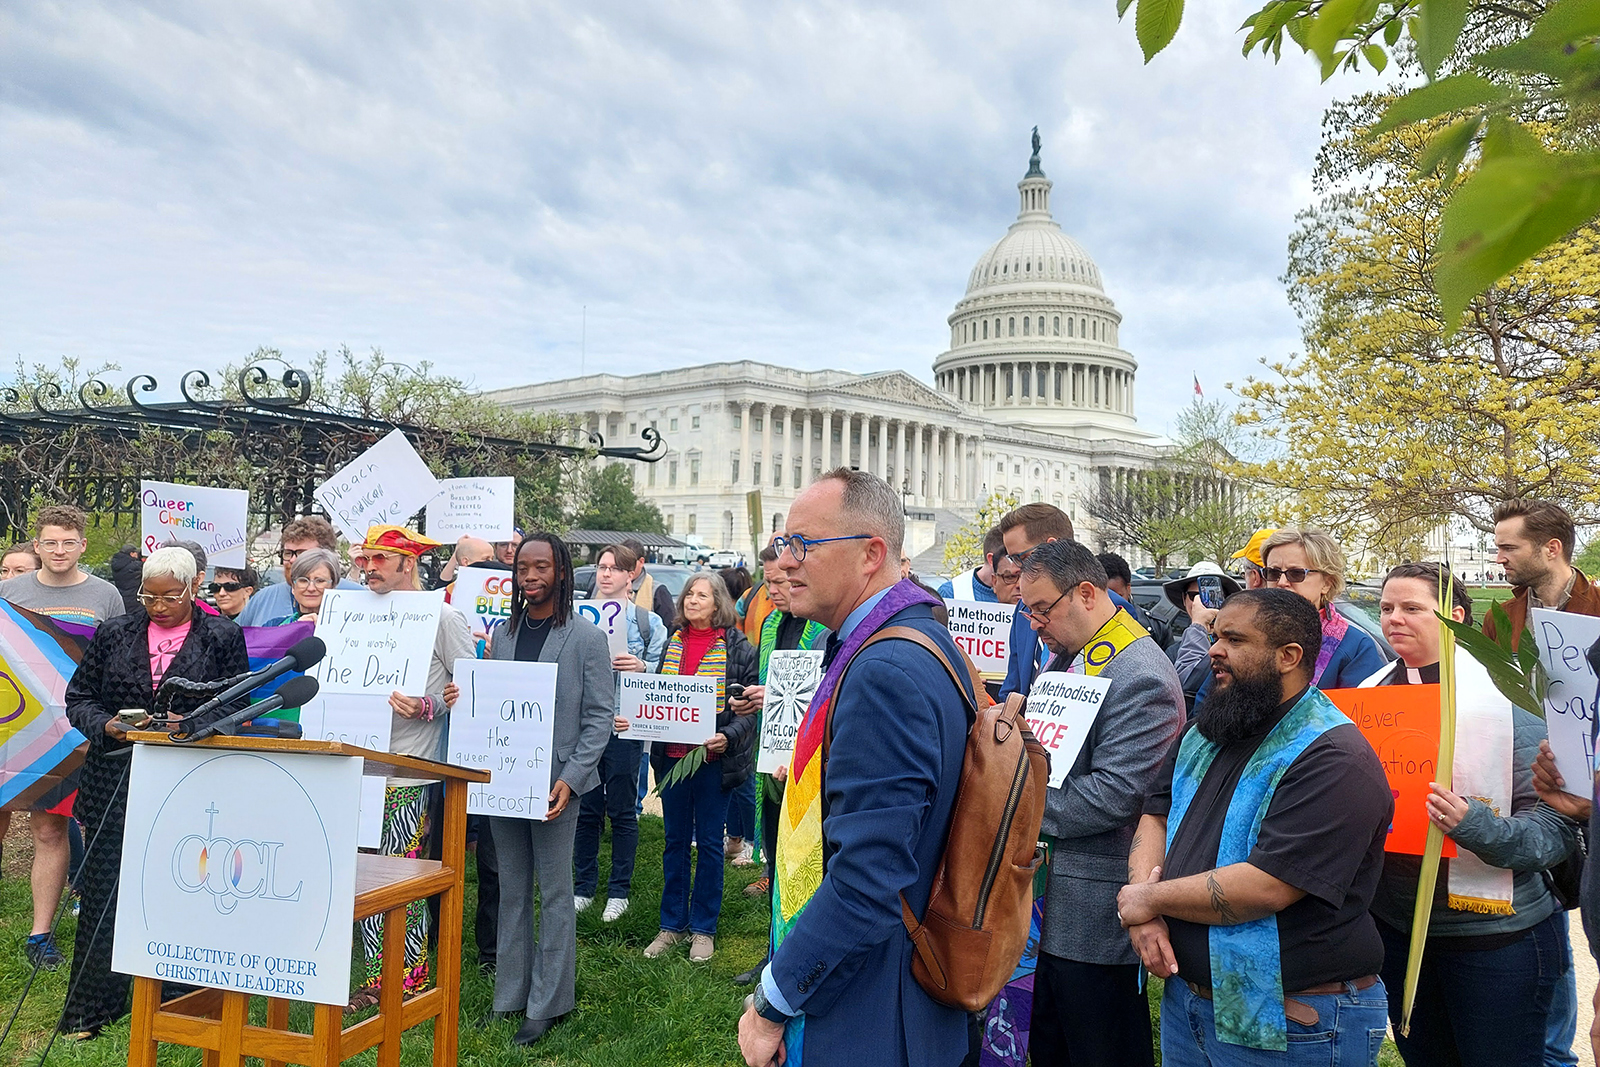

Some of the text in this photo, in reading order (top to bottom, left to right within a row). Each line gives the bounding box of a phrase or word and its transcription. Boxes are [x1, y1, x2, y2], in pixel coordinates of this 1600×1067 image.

[142, 490, 194, 512] Queer
[159, 510, 215, 532] Christian
[203, 528, 245, 555] nafraid
[485, 576, 512, 596] GO
[320, 594, 341, 625] If
[340, 610, 364, 634] you
[400, 611, 434, 628] power
[476, 596, 512, 616] BLE
[958, 607, 1014, 624] Methodis
[949, 620, 996, 636] tand for
[340, 636, 360, 656] you
[952, 636, 1005, 660] STICE
[363, 654, 410, 688] Devil
[470, 670, 543, 722] I am
[624, 678, 714, 694] United Methodists
[1040, 680, 1102, 705] Methodists
[645, 692, 691, 704] stand for
[1026, 699, 1067, 718] tand for
[636, 704, 700, 722] JUSTICE
[1350, 702, 1404, 729] Never
[486, 726, 511, 749] the
[766, 723, 798, 738] WELCO
[1027, 719, 1069, 750] TICE
[456, 746, 545, 774] queer joy of
[1379, 746, 1434, 775] ation
[468, 783, 541, 815] ntecost
[146, 940, 318, 978] COLLECTIVE OF QUEER
[155, 961, 306, 996] CHRISTIAN LEADERS
